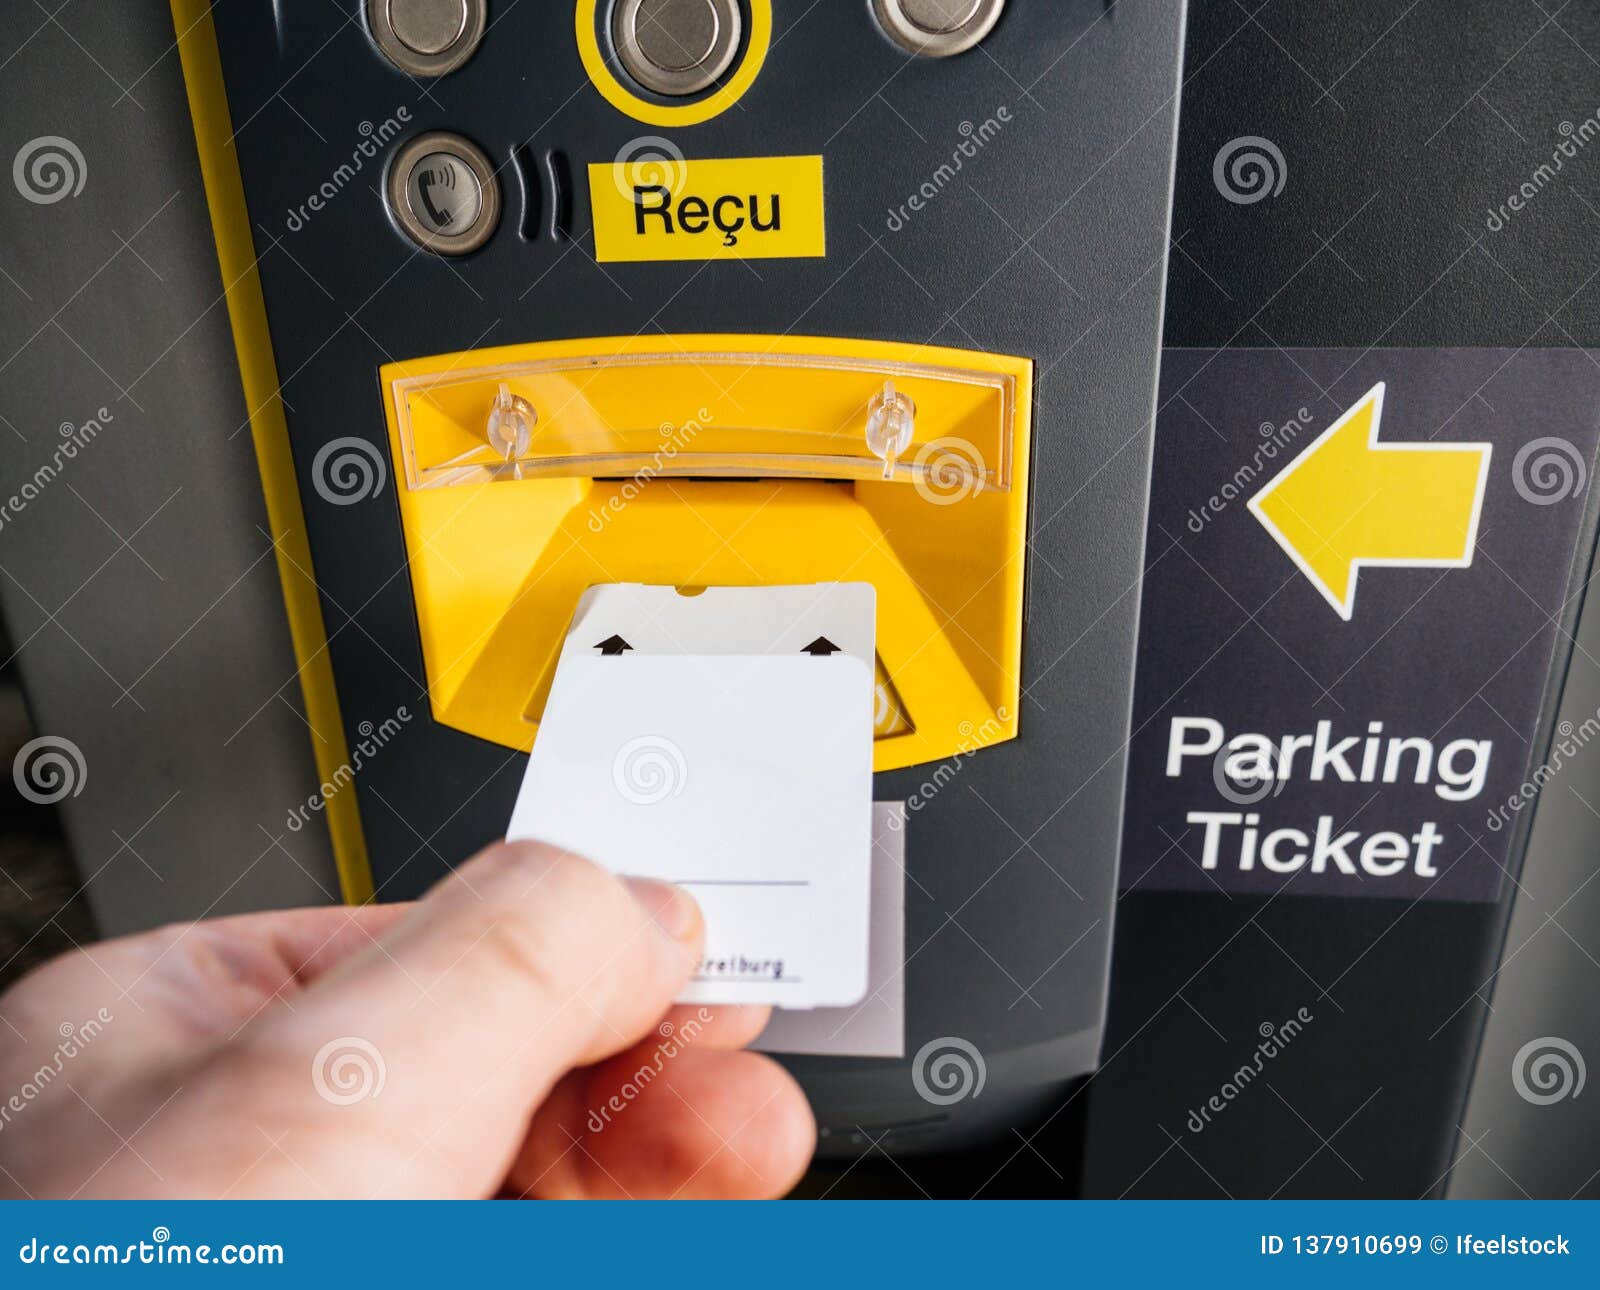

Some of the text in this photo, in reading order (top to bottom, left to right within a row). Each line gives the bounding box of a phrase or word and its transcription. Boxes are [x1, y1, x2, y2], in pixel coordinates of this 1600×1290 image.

[633, 184, 781, 247] Reçu
[1166, 716, 1493, 802] Parking
[1186, 811, 1444, 878] Ticket
